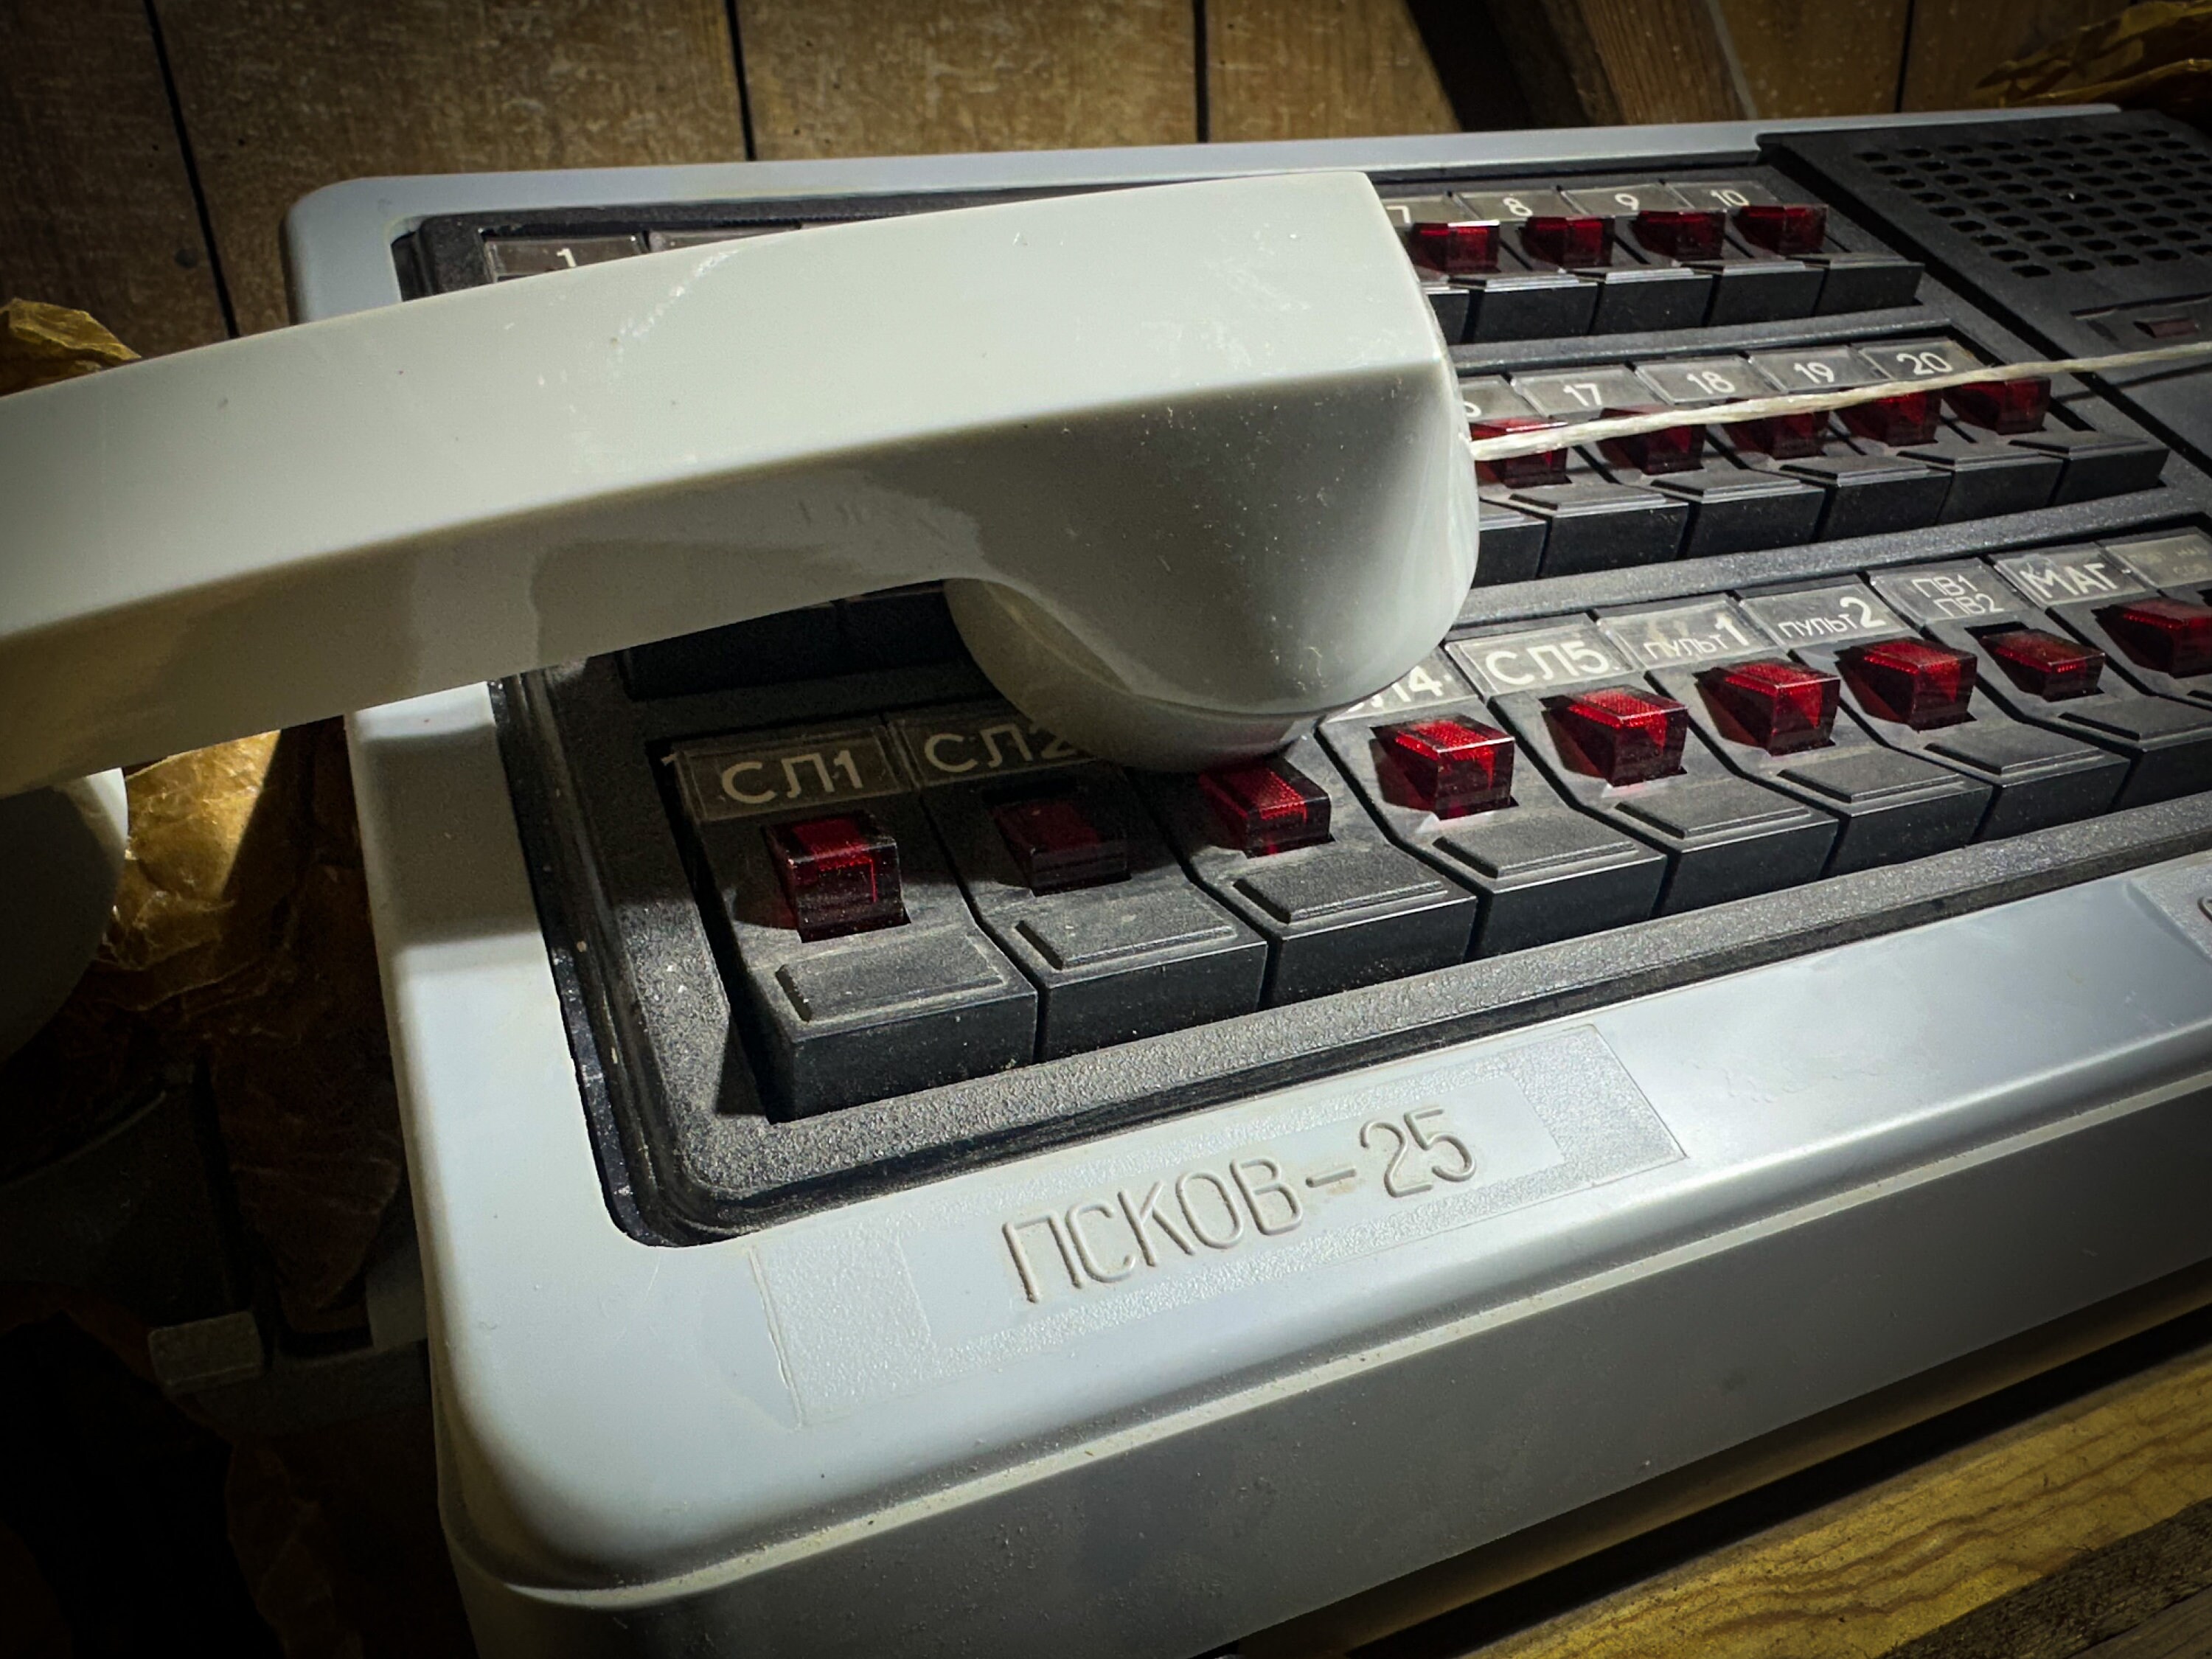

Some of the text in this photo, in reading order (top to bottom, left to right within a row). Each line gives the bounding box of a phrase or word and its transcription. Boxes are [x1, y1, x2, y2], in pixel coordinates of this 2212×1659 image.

[1502, 197, 1534, 217] 8
[1614, 193, 1641, 211] 9
[1710, 189, 1750, 207] 10
[1386, 205, 1411, 224] 7
[556, 248, 577, 268] 1
[1793, 361, 1835, 383] 19
[1896, 352, 1953, 375] 20
[1686, 370, 1736, 394] 18
[1563, 383, 1603, 406] 17
[1911, 574, 1978, 598] ПВ1
[2019, 563, 2118, 599] МАГ
[1933, 593, 2005, 617] ПВ2
[1485, 639, 1610, 686] СЛ5
[721, 749, 863, 804] СЛ1
